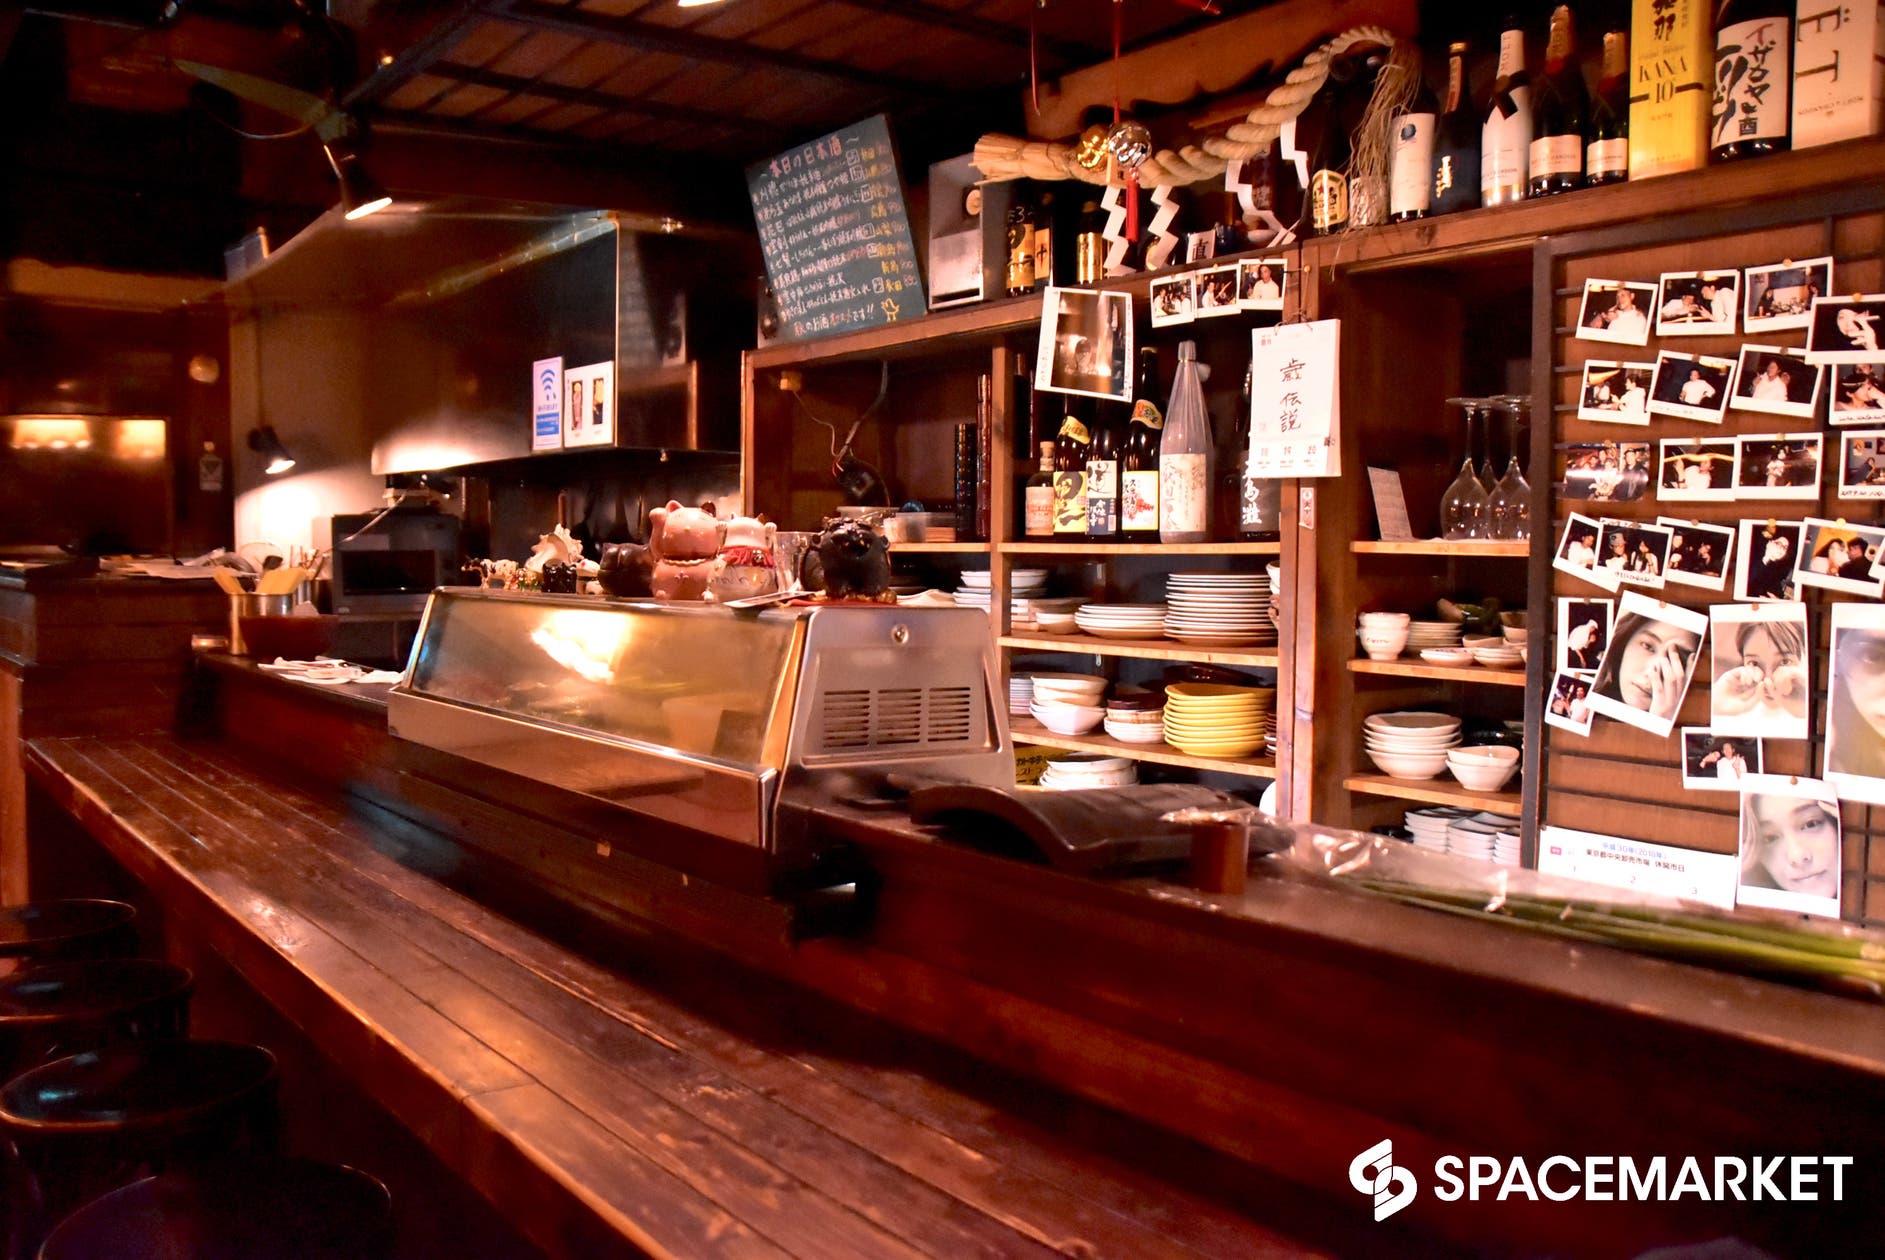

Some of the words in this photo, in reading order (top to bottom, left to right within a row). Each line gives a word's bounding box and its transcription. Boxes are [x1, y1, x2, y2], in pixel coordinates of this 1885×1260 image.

[1639, 55, 1687, 83] KANA
[1656, 80, 1674, 104] 10
[769, 134, 843, 178] 本日の日本酒
